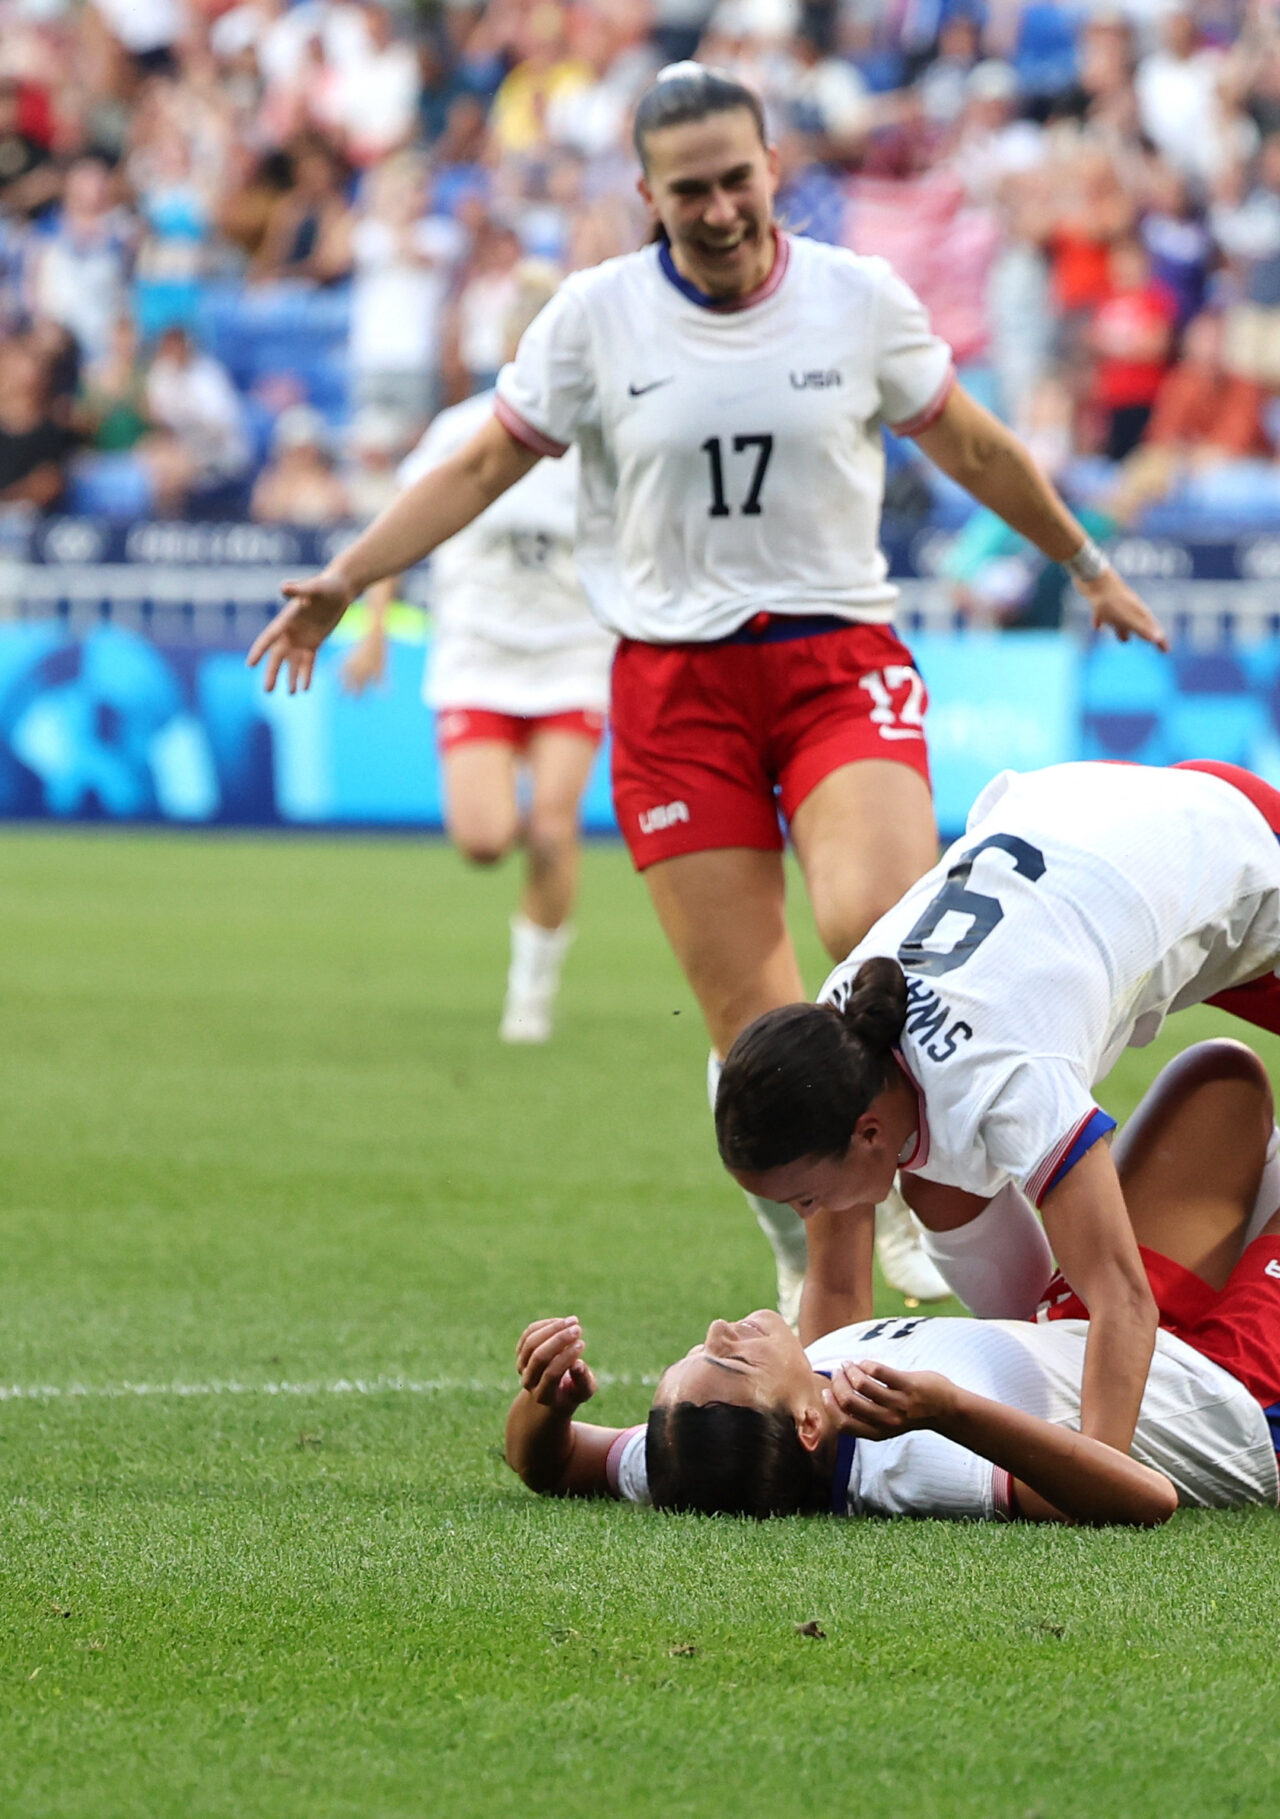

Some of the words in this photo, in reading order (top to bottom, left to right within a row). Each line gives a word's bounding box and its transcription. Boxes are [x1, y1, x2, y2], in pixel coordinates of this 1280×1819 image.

[789, 370, 842, 390] USA
[702, 434, 773, 517] 17
[638, 800, 690, 834] USA
